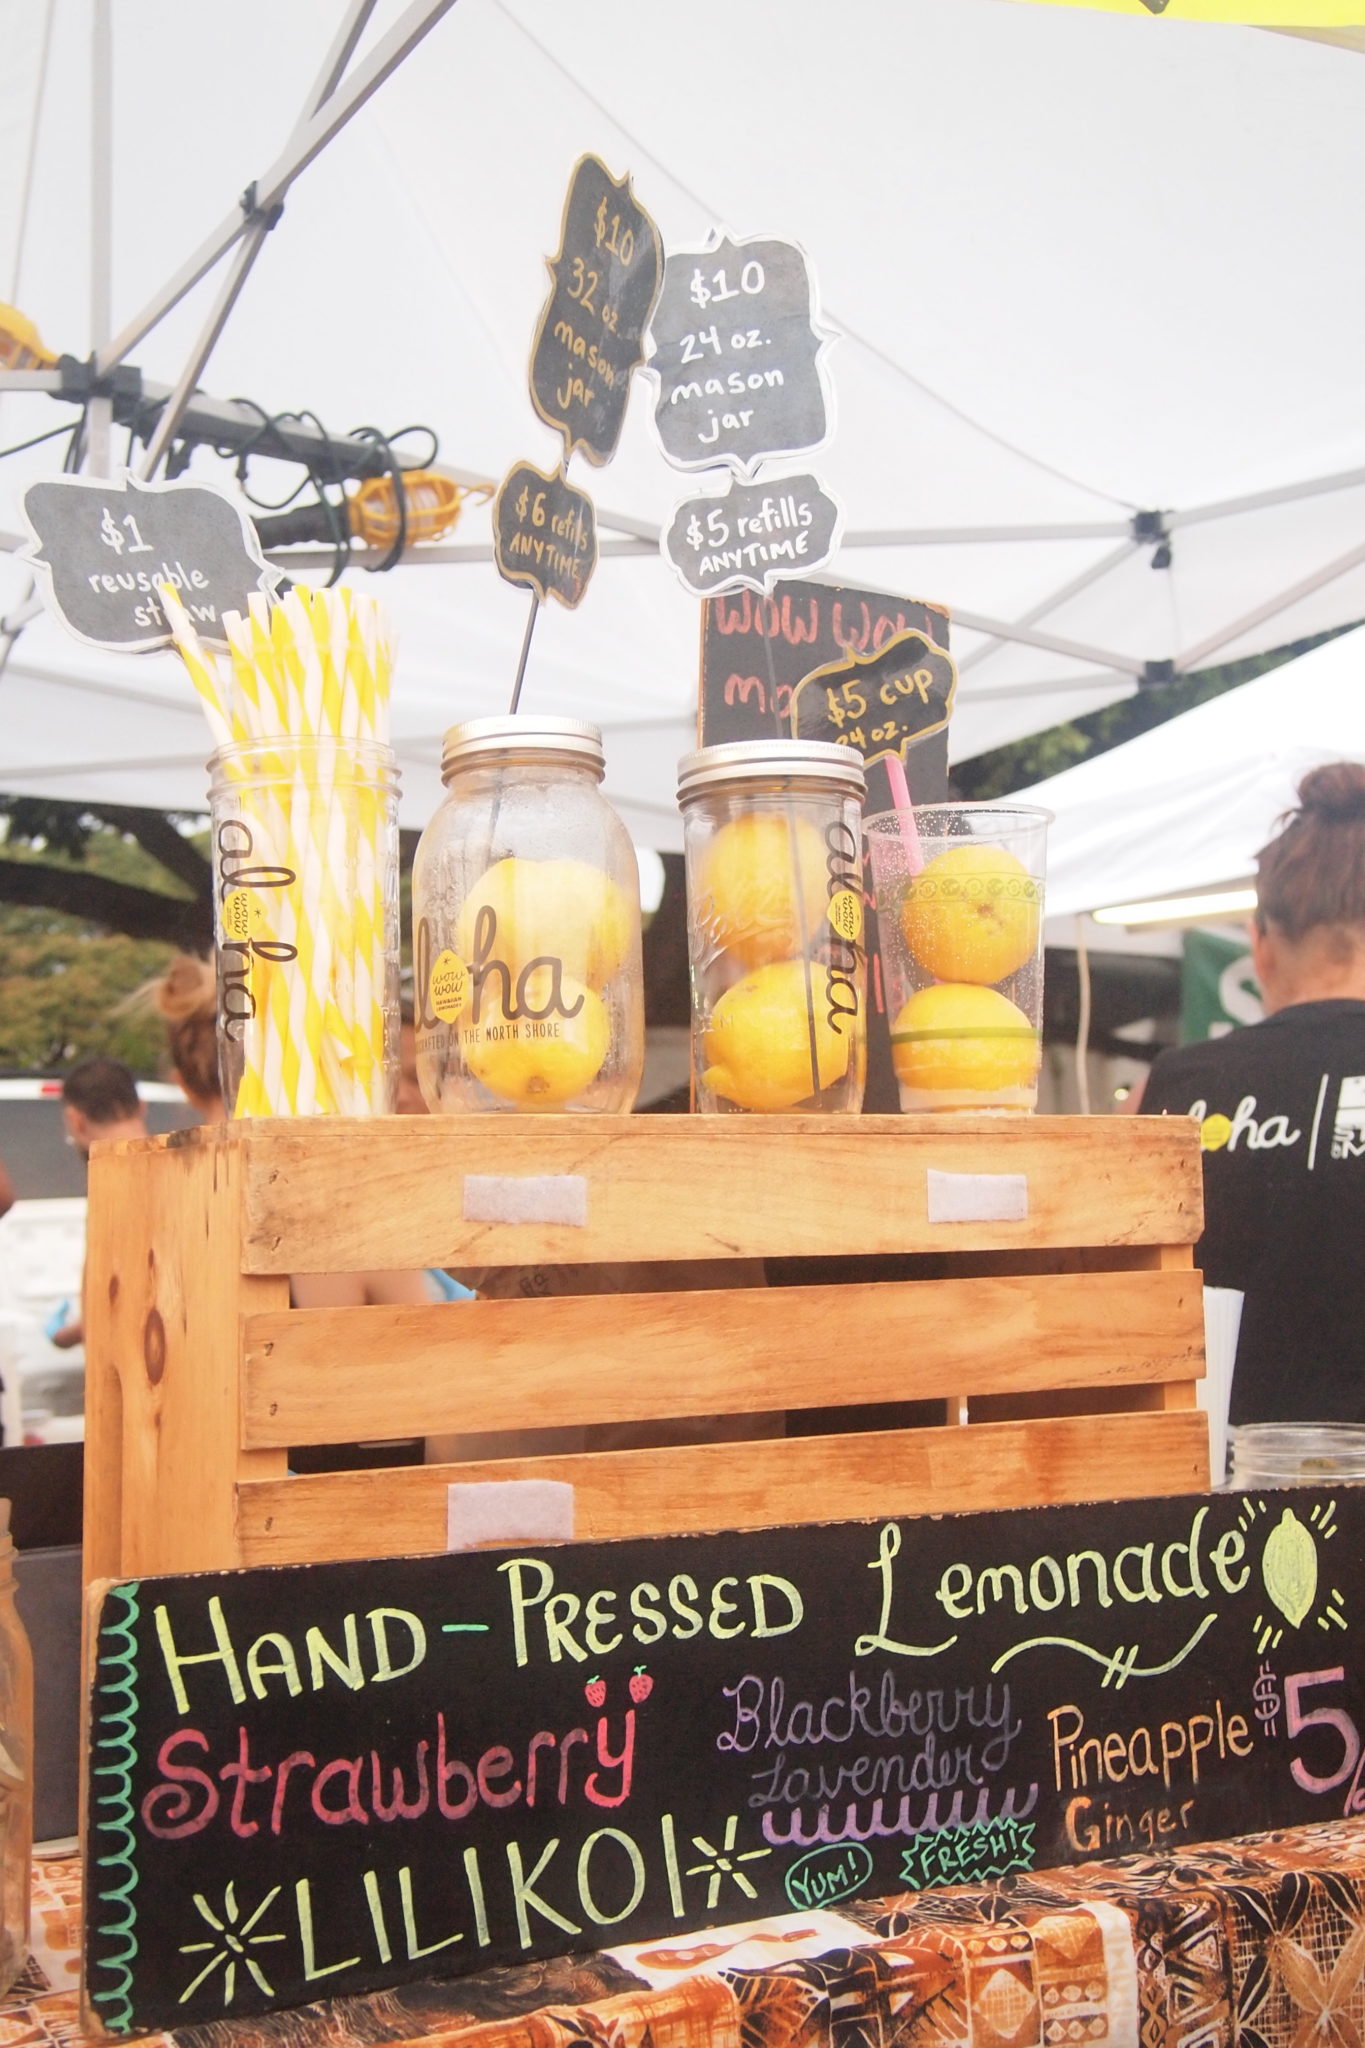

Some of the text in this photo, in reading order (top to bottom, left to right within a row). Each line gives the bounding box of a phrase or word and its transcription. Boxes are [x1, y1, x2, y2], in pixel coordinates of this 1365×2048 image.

[594, 196, 634, 266] $10
[567, 257, 598, 315] 32
[690, 261, 765, 309] $10
[554, 321, 616, 390] mason
[680, 326, 771, 364] 24 oz.
[557, 363, 594, 409] jar
[671, 368, 784, 404] mason
[698, 409, 754, 443] jar
[100, 507, 154, 555] $1
[686, 495, 813, 551] $5 refills
[88, 561, 209, 593] reusable
[509, 532, 581, 577] ANYTIME
[699, 530, 809, 576] ANYTIME
[134, 596, 216, 628] stw
[832, 601, 933, 651] WO
[826, 679, 867, 728] $5
[871, 721, 908, 741] oz.
[434, 981, 463, 996] wow
[464, 1028, 480, 1044] THE
[486, 1024, 519, 1041] NORTH
[525, 1023, 560, 1038] SHORE
[855, 1507, 1251, 1656] Lemonade
[716, 1668, 1022, 1772] Blackberry
[749, 1730, 983, 1808] Lavender
[1047, 1699, 1254, 1792] Pineapple
[141, 1709, 636, 1839] Strawberry
[1065, 1796, 1194, 1851] Ginger
[792, 1851, 862, 1905] YUM!
[920, 1830, 1020, 1879] FRESH!
[296, 1815, 685, 1981] LILIKOI
